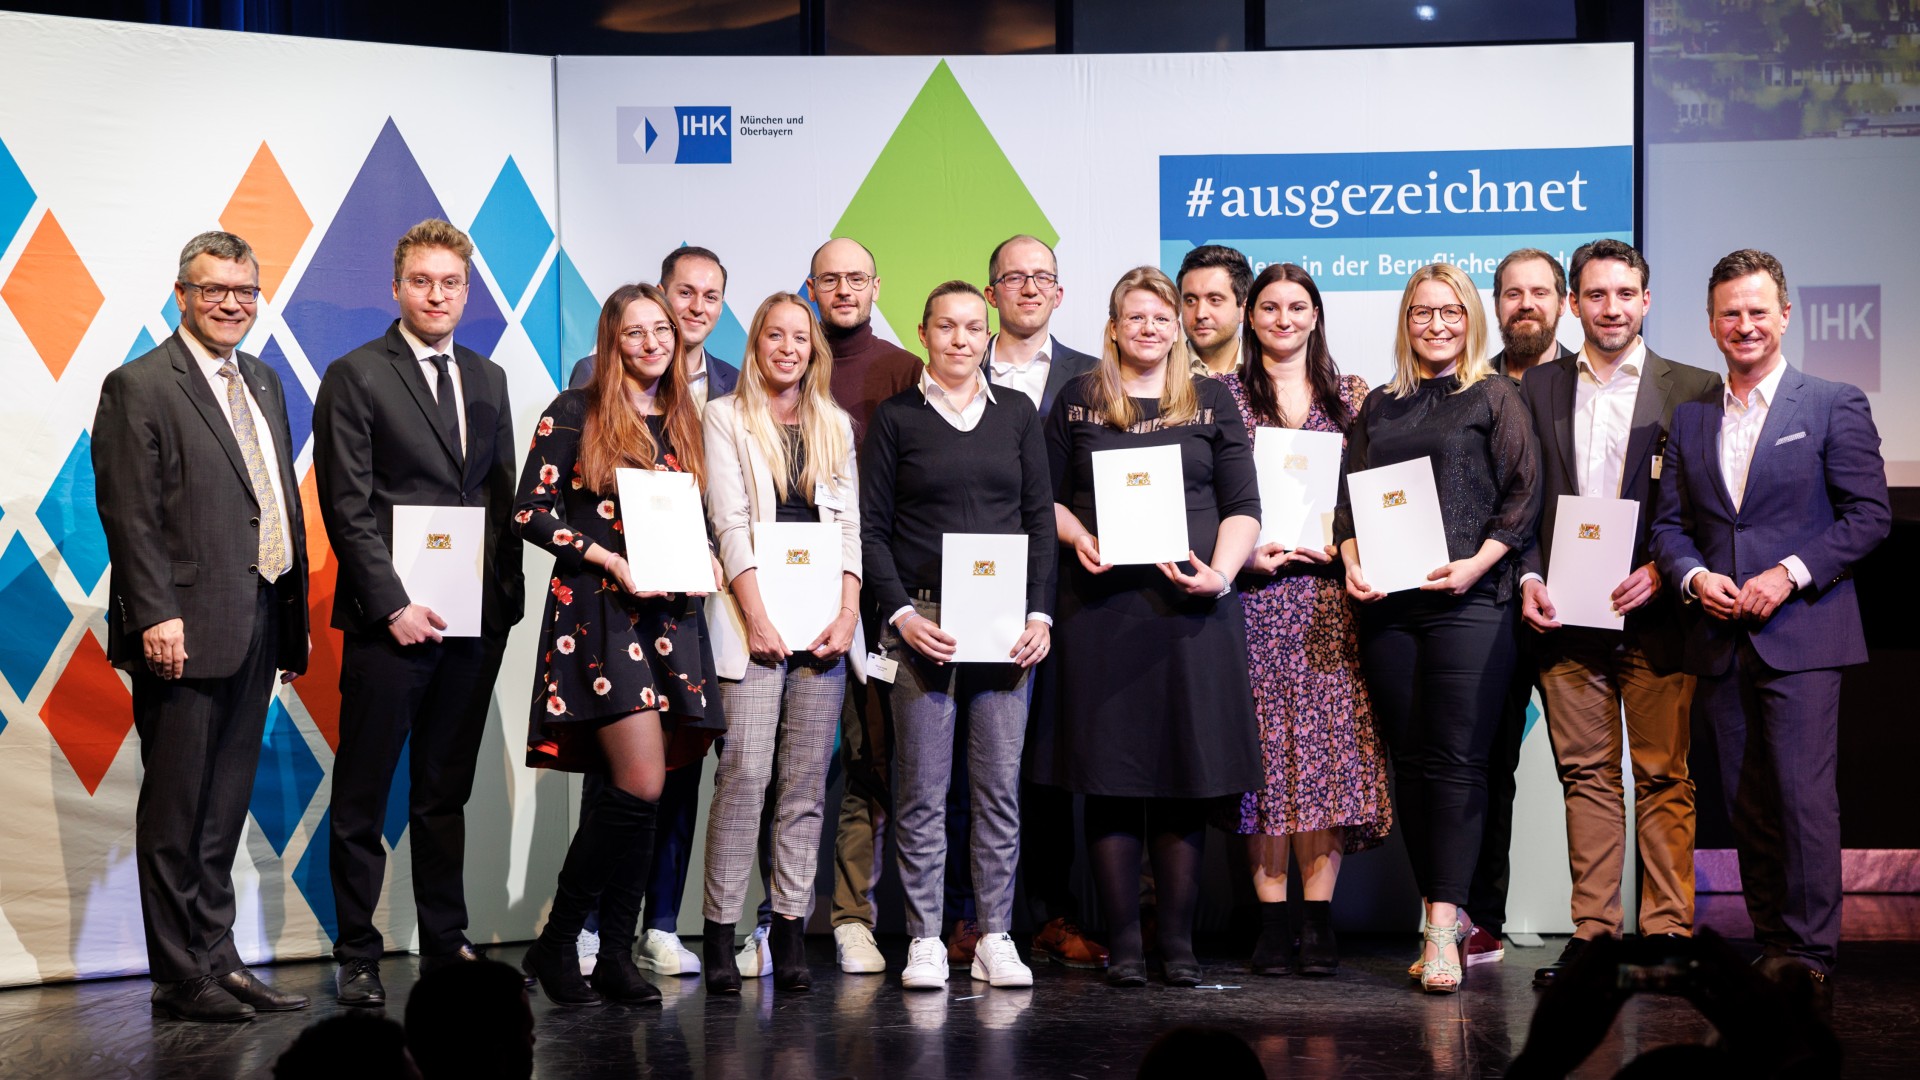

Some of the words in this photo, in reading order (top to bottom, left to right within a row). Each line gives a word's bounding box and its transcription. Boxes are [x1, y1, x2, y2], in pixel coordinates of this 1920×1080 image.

[682, 115, 728, 136] IHK
[740, 115, 783, 125] München
[786, 115, 804, 125] und
[740, 126, 793, 138] Oberbayern
[1186, 168, 1588, 229] #ausgezeichnet
[1302, 255, 1323, 276] in
[1332, 255, 1369, 276] der
[1378, 252, 1504, 276] Berfliche
[1810, 303, 1875, 341] IHK
